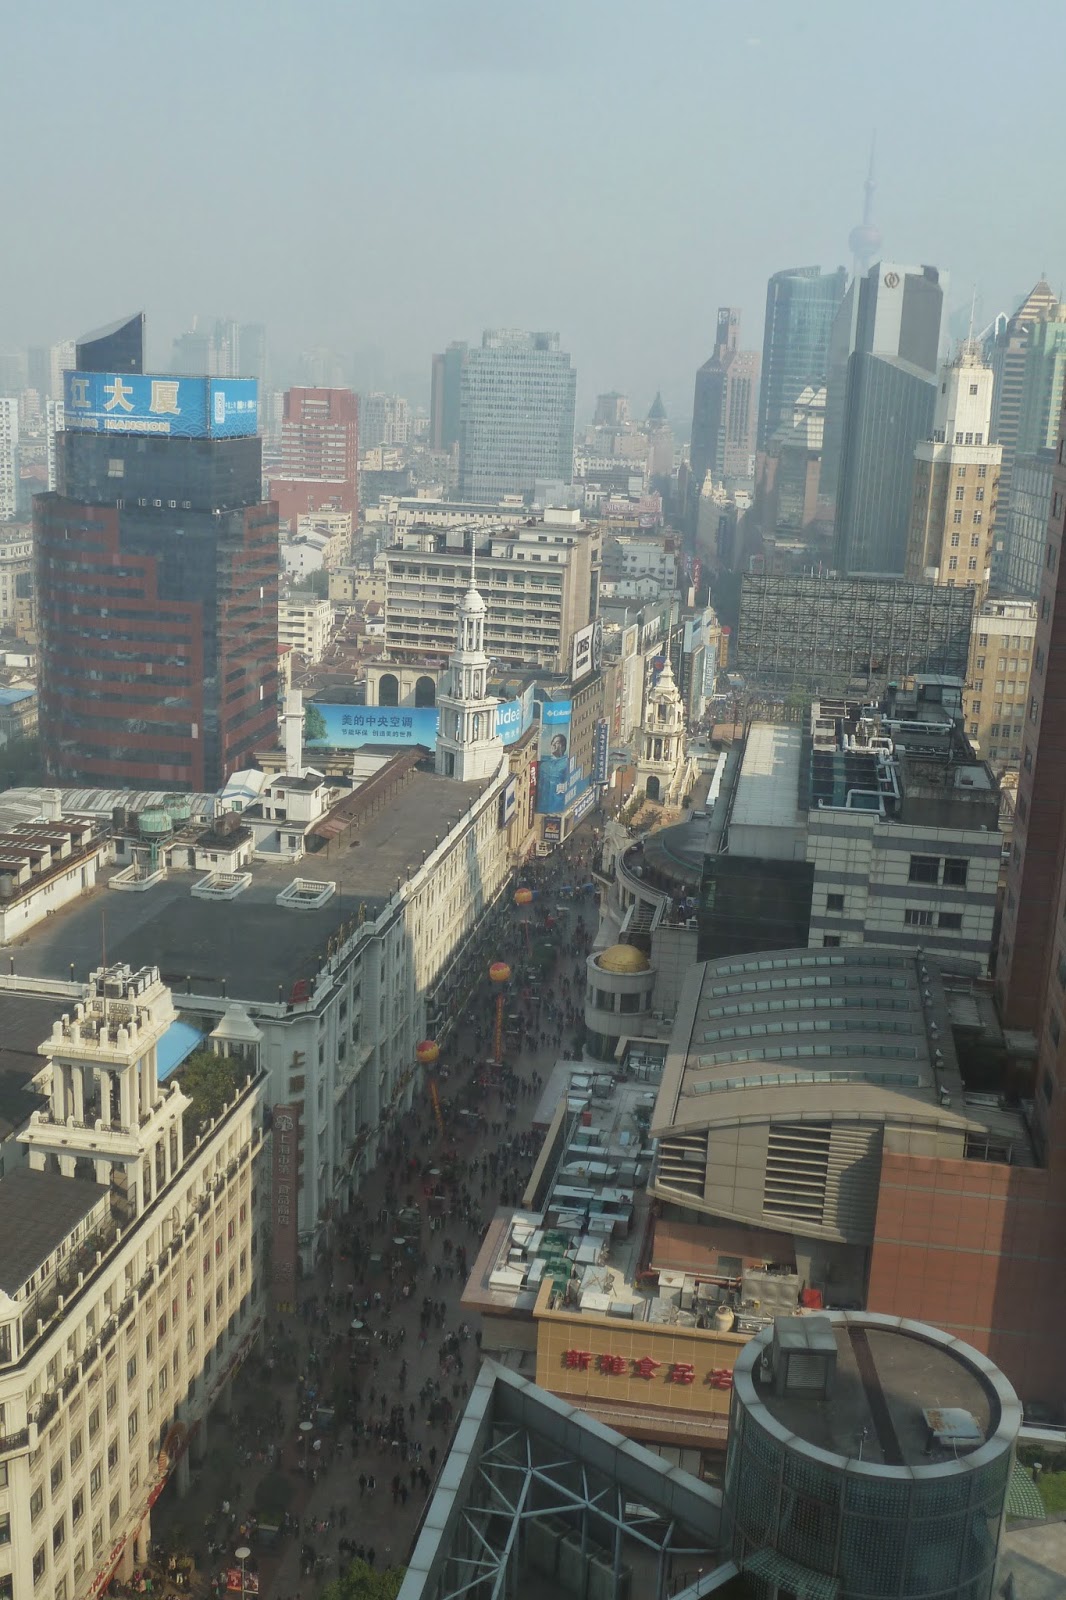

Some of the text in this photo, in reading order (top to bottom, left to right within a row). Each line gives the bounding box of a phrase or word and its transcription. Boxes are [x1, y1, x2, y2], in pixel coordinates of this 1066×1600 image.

[341, 714, 413, 728] 美的中央空调
